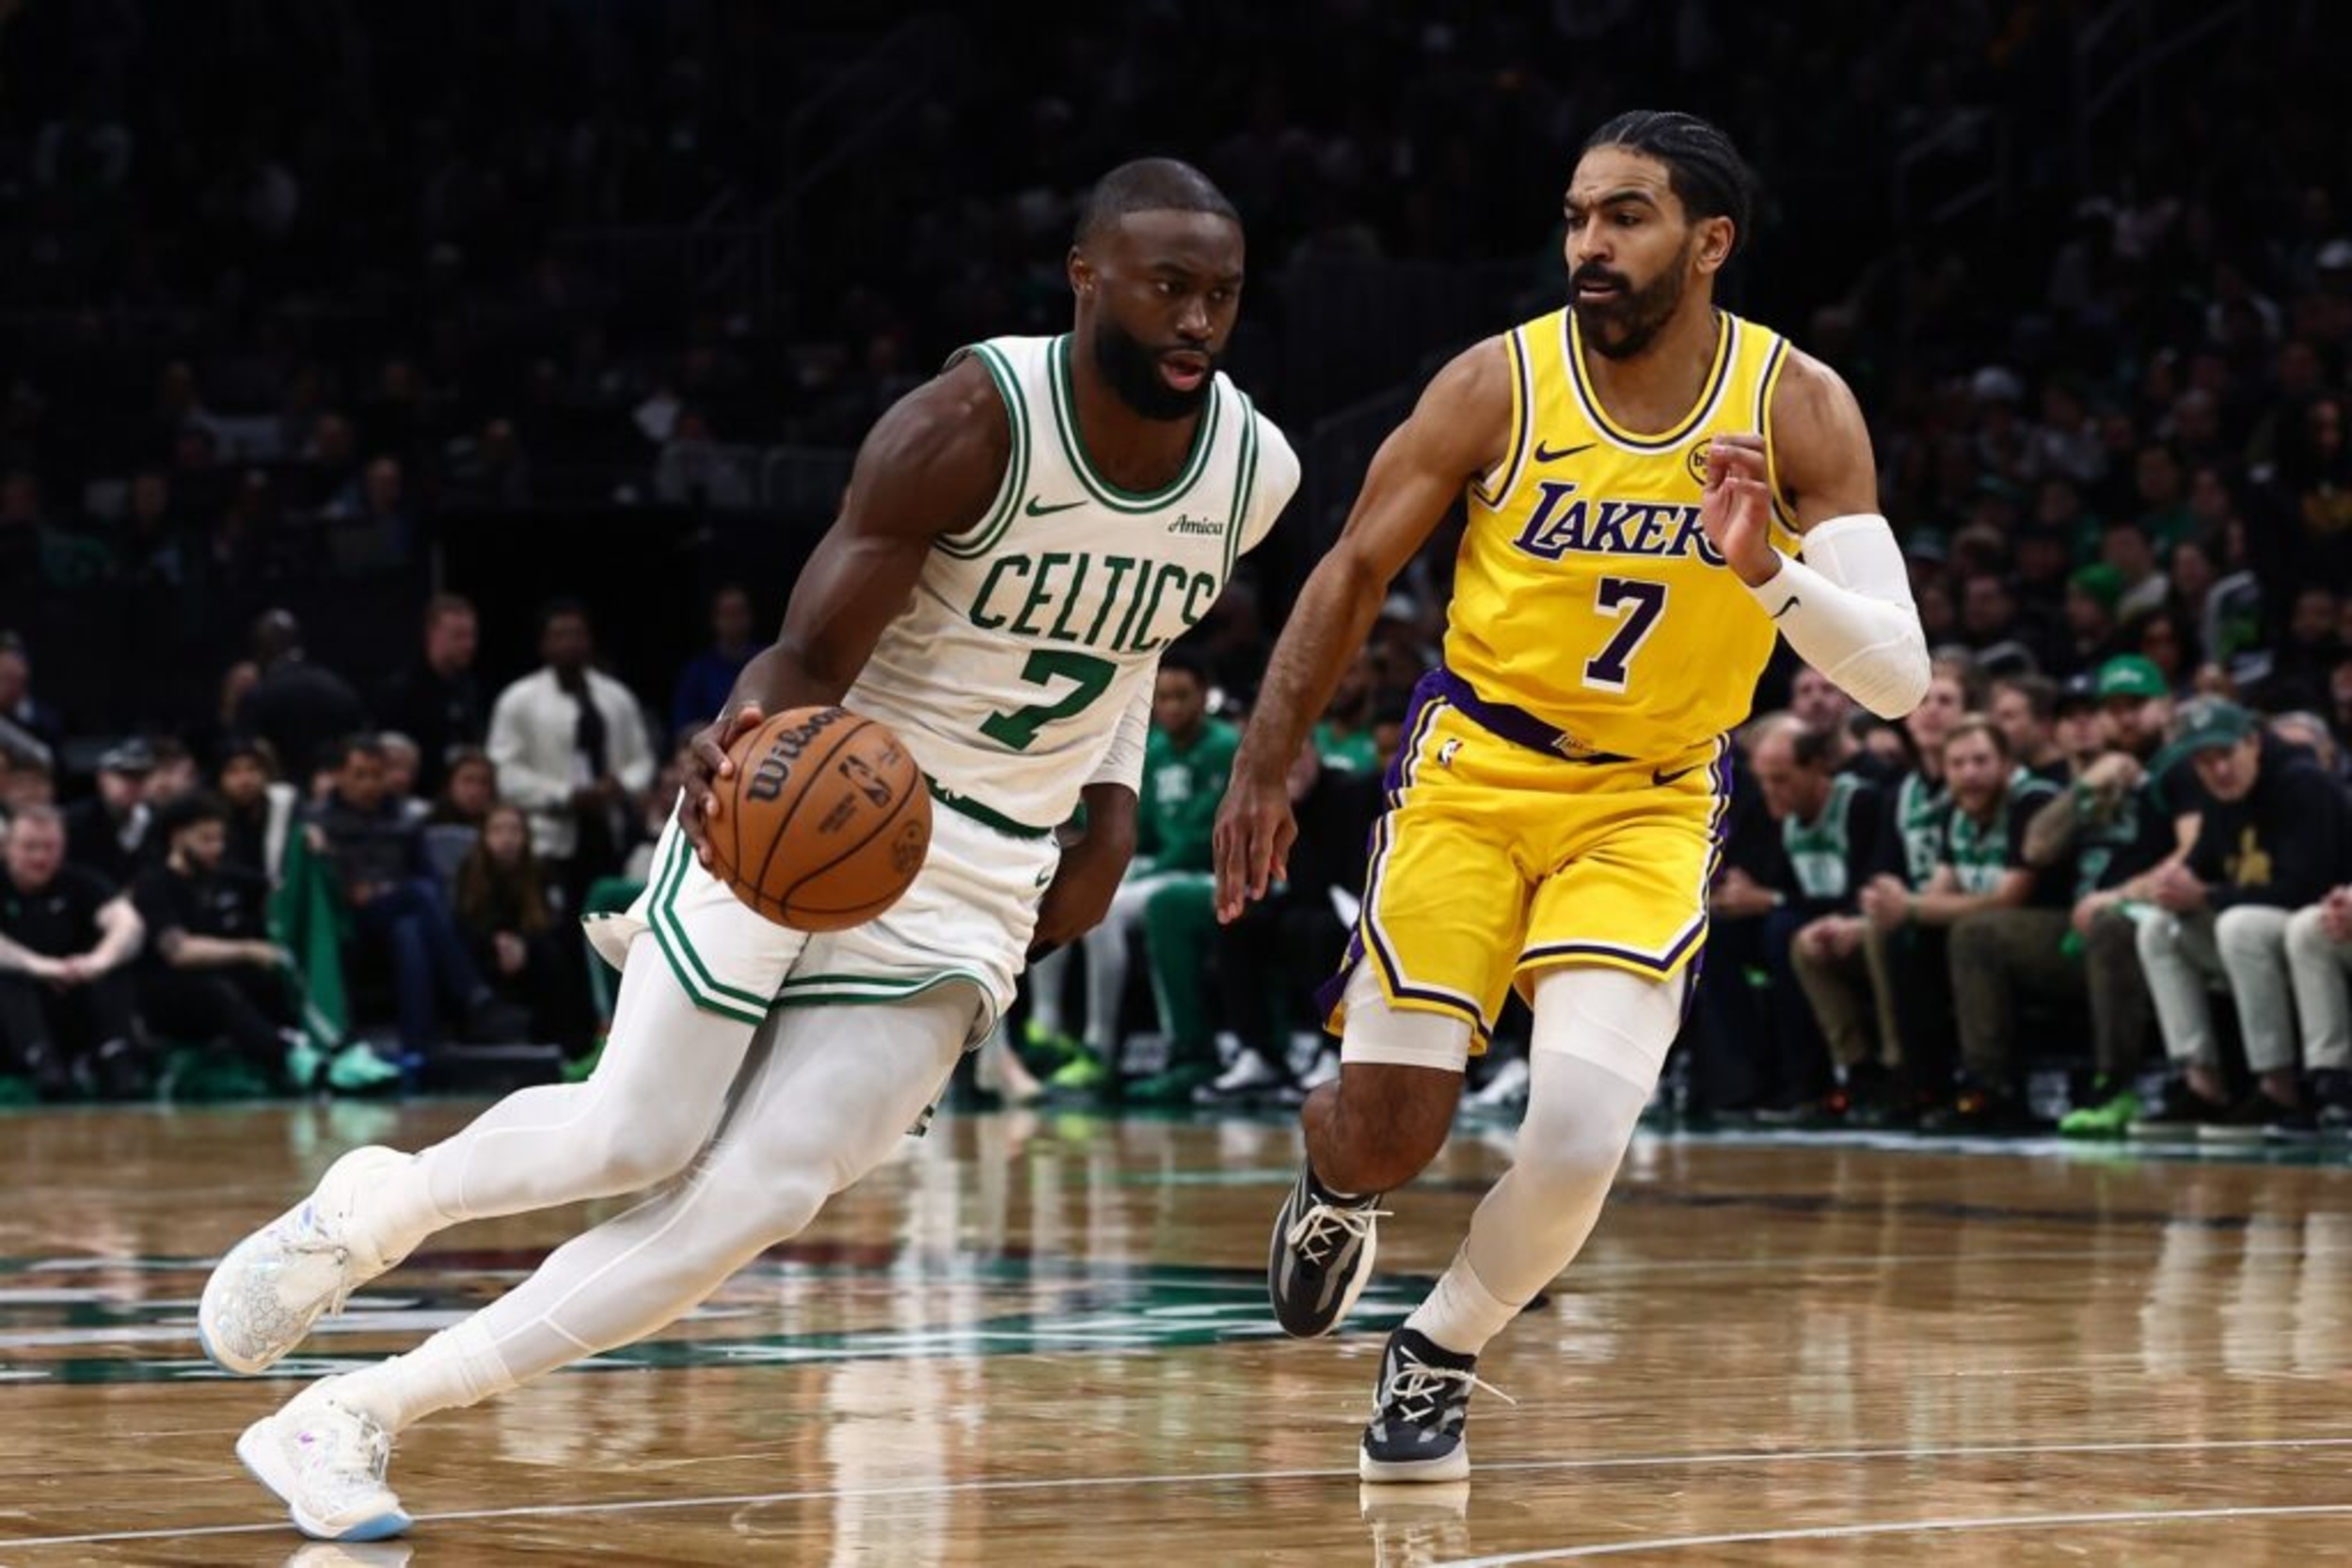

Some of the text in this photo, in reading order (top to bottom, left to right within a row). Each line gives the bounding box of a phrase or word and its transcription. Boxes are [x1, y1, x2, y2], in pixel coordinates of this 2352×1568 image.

[1168, 514, 1223, 535] Amica
[1513, 481, 1728, 567] LAKER
[1582, 577, 1667, 693] 7
[978, 649, 1118, 751] 7
